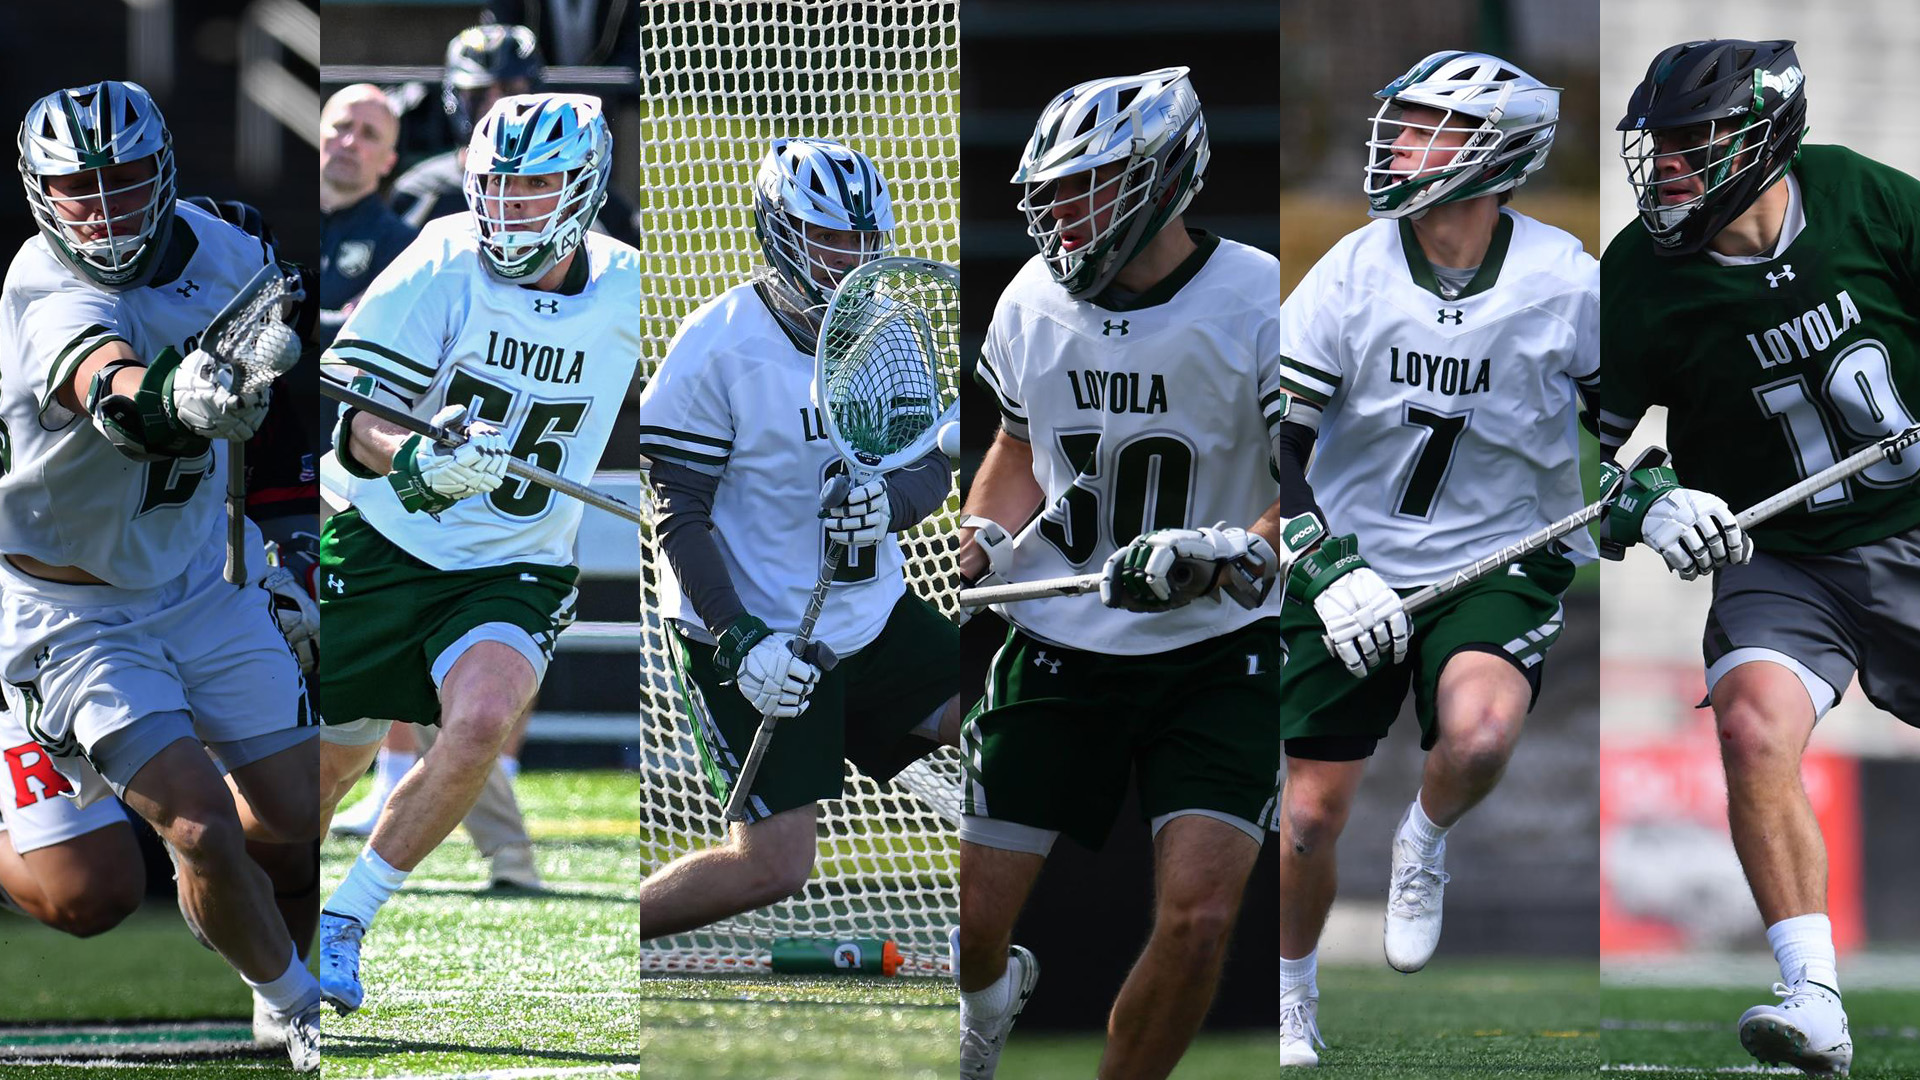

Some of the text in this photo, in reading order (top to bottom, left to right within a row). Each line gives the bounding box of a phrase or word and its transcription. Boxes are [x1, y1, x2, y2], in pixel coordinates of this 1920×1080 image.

[1746, 290, 1861, 369] LOYOLA
[485, 330, 585, 384] LOYOLA
[1390, 347, 1490, 396] LOYOLA
[1067, 370, 1168, 414] LOYOLA
[1752, 339, 1920, 513] 19
[1389, 399, 1475, 524] 7
[1036, 427, 1199, 570] 50
[1290, 523, 1316, 546] EPOCH
[1335, 554, 1361, 570] EPOCH
[735, 629, 758, 653] EPOCH
[4, 740, 76, 809] R
